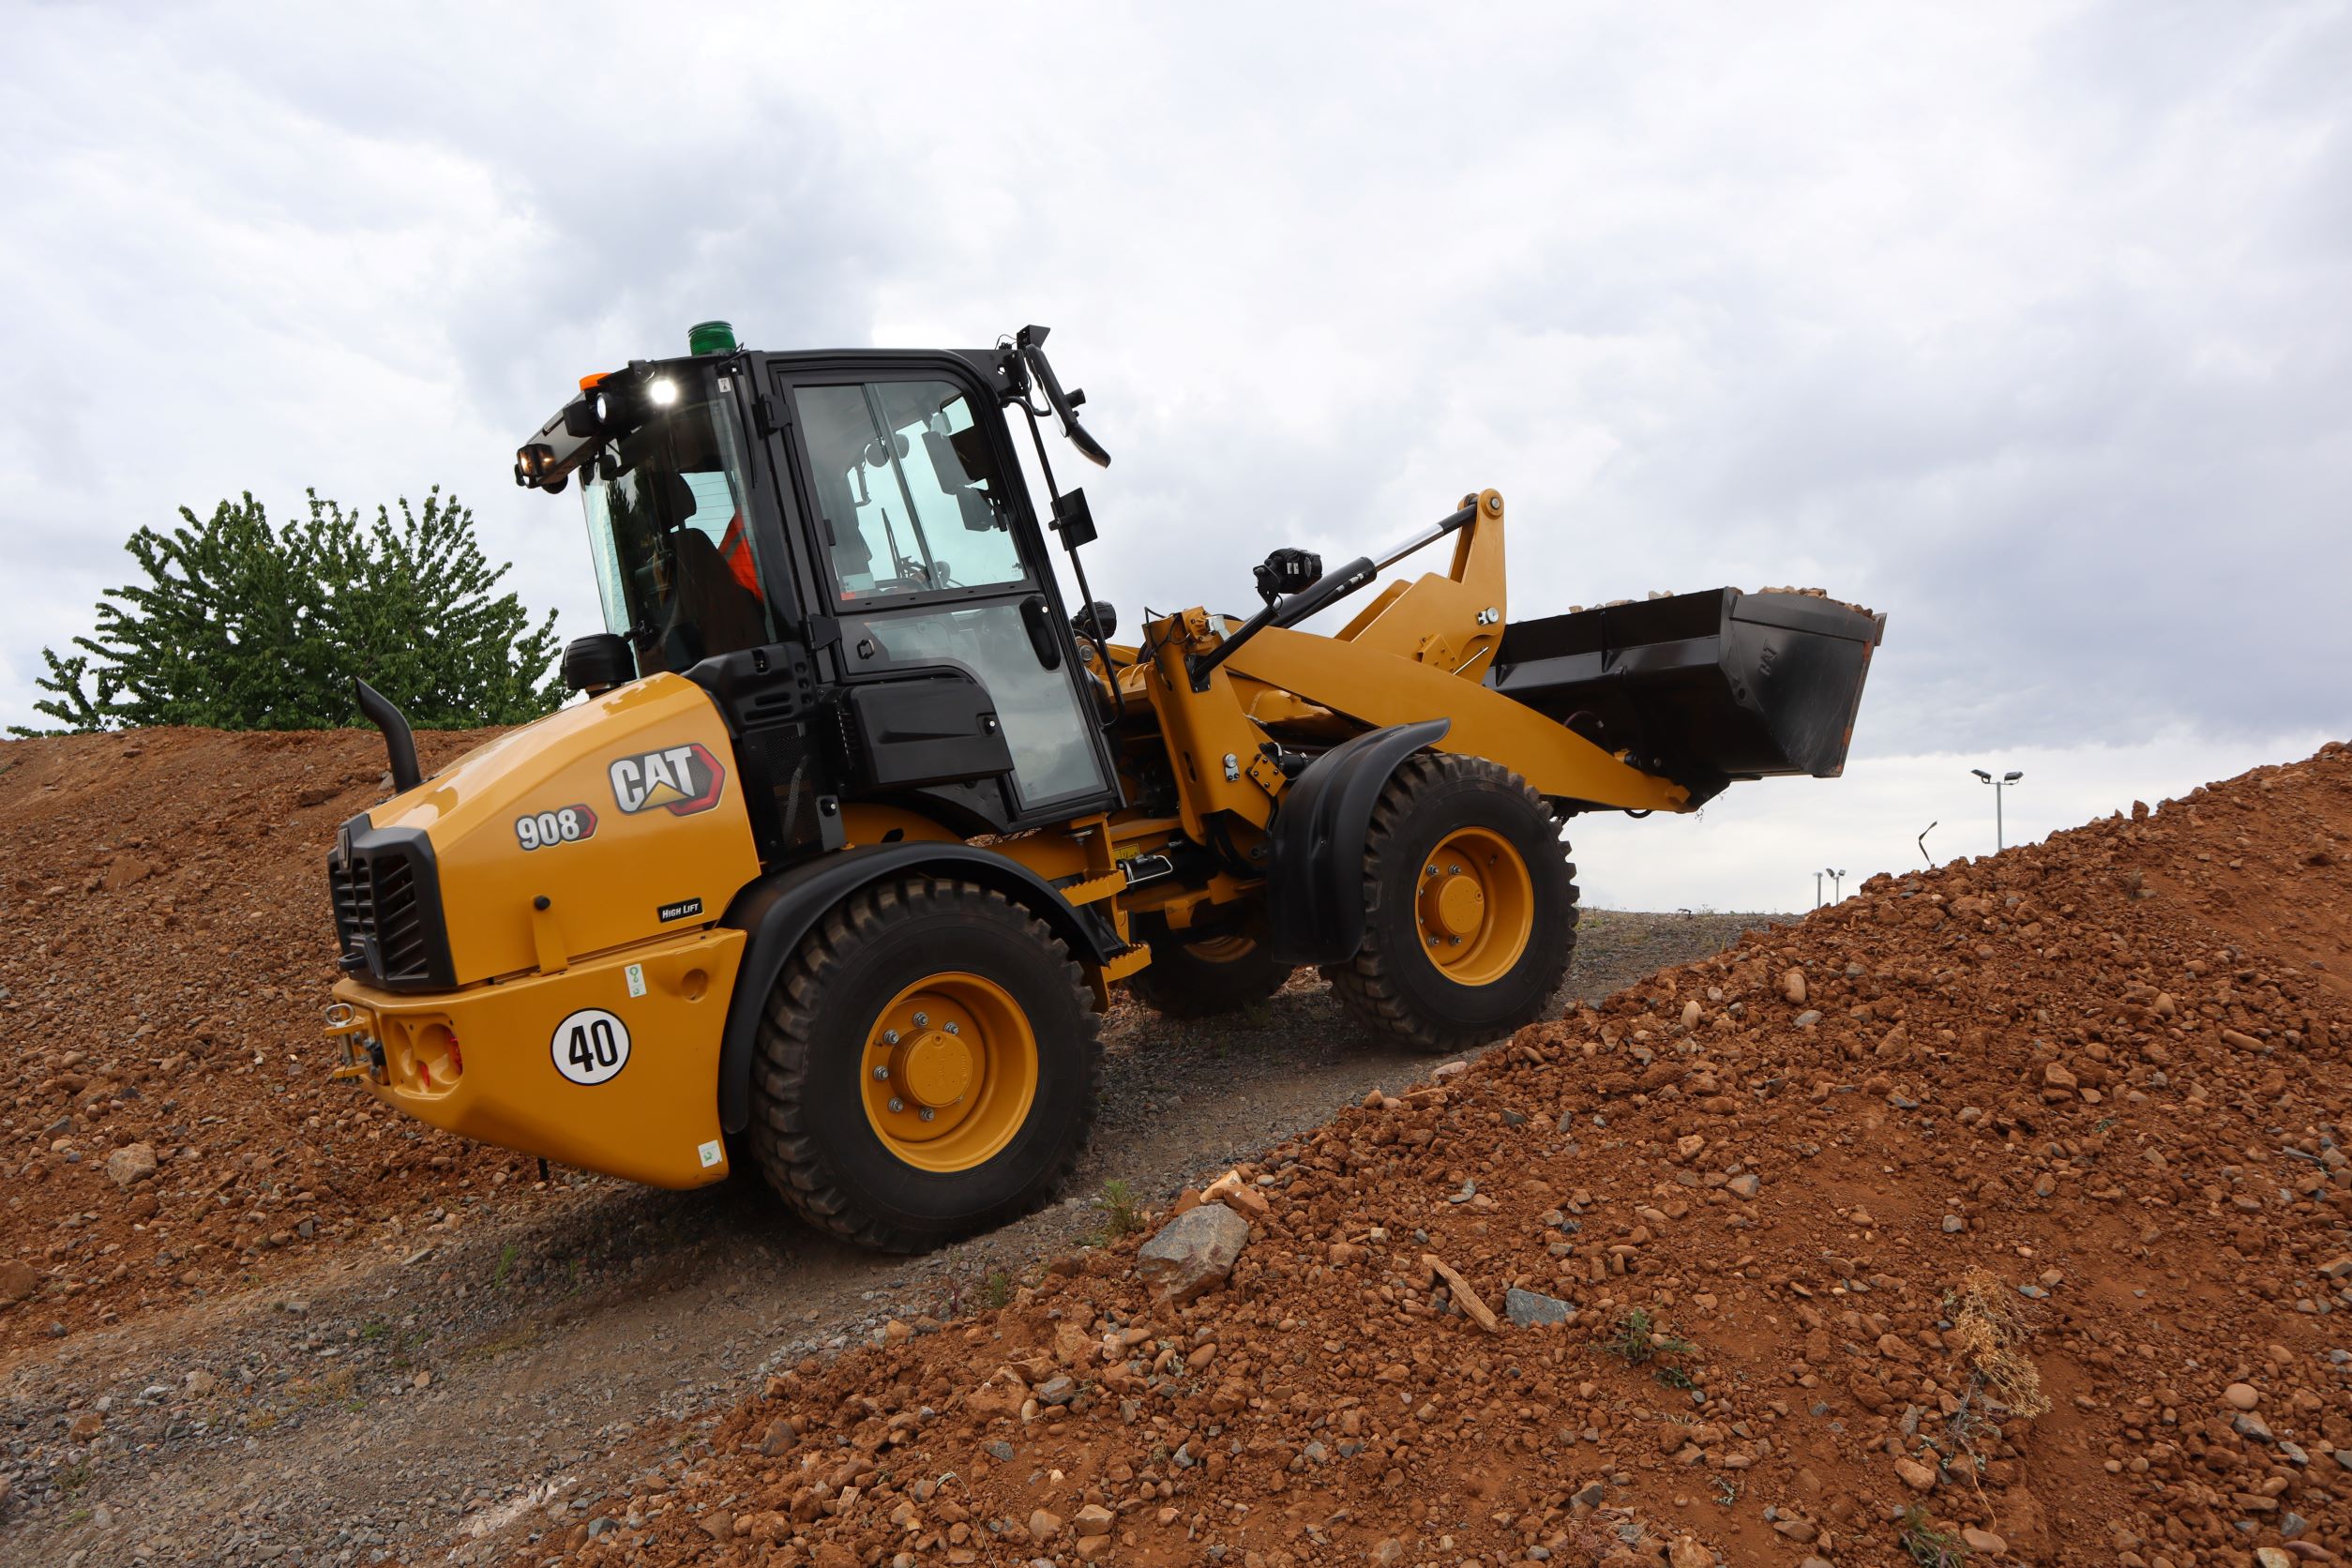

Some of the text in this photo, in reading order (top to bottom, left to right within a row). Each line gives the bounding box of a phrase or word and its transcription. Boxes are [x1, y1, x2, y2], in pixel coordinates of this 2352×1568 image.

[610, 746, 696, 813] CAT
[517, 808, 580, 850] 908
[662, 903, 700, 919] HIGH LIFT
[568, 1018, 619, 1073] 40
